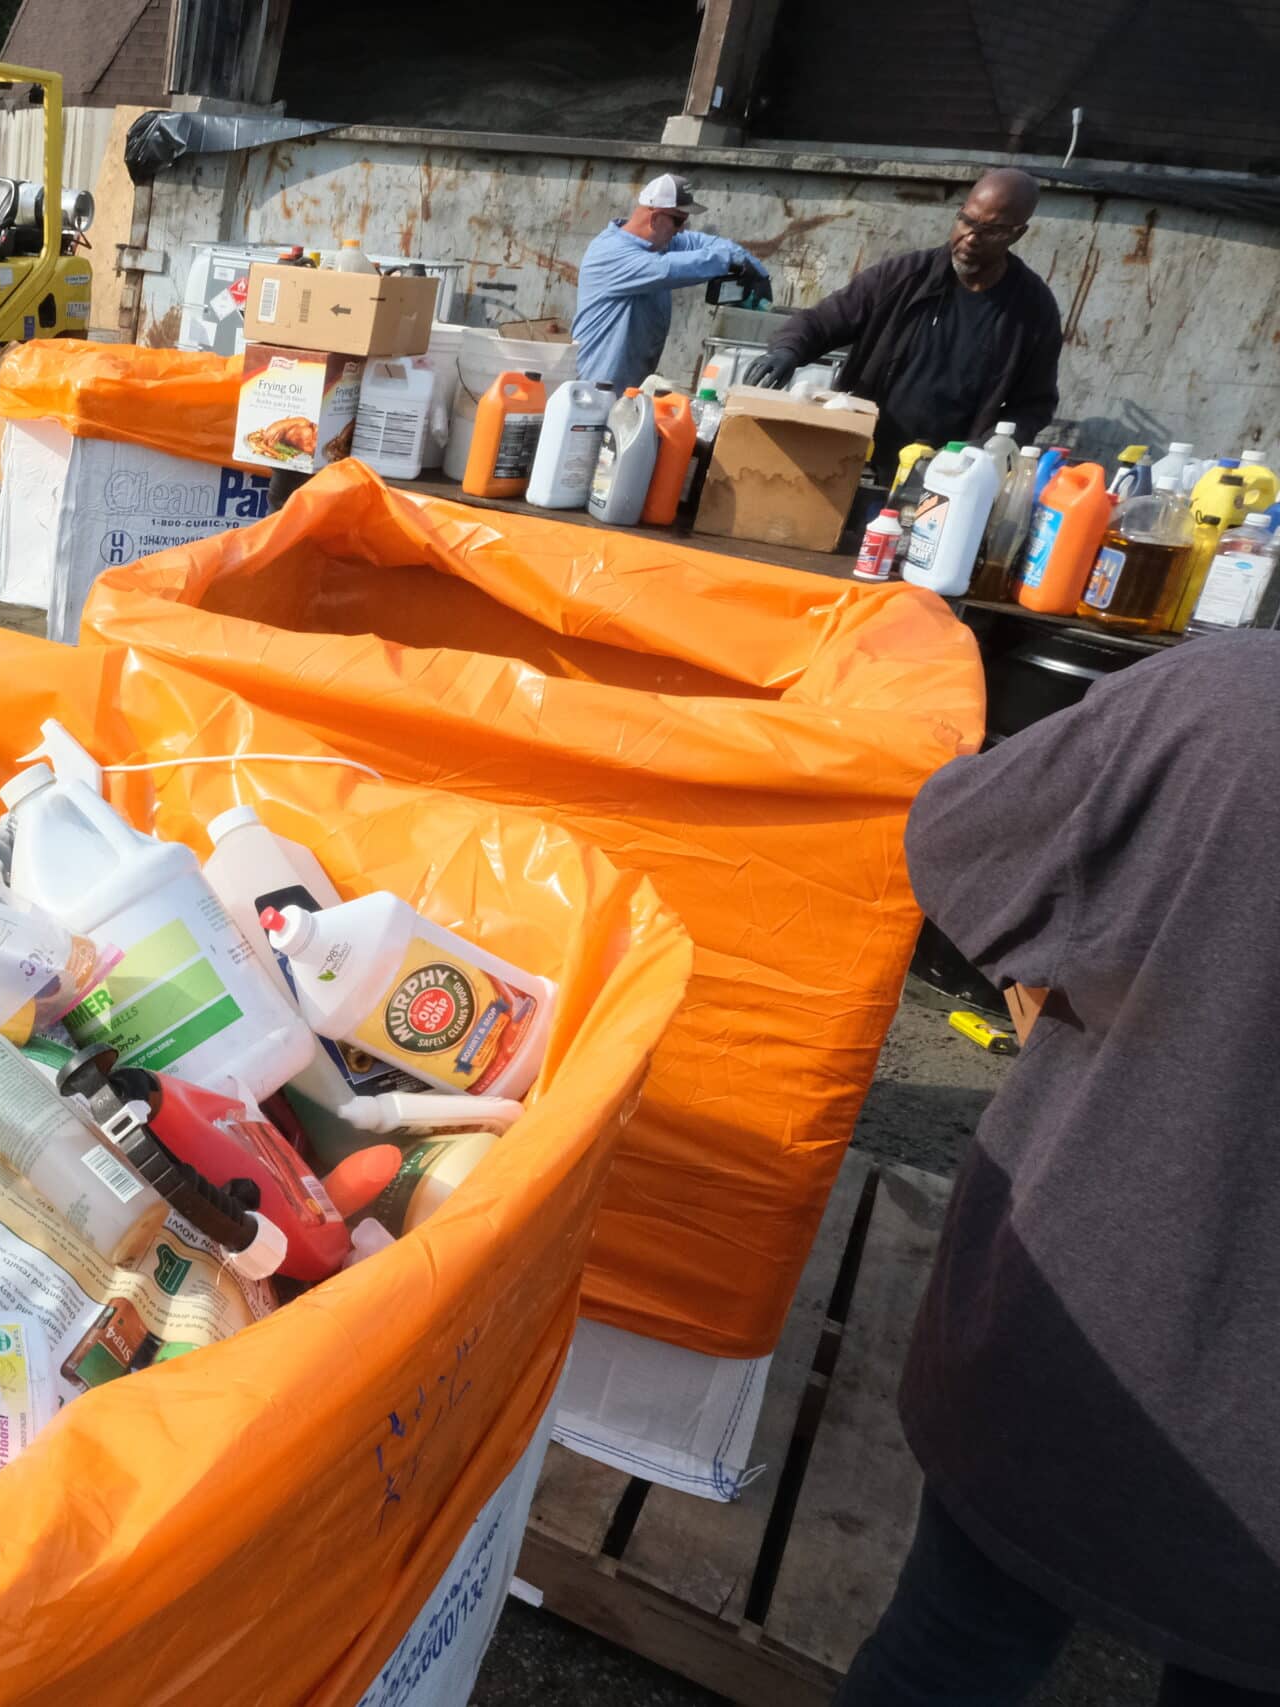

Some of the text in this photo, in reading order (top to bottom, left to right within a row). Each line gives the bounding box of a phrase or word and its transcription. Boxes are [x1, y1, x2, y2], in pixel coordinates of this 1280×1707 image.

[258, 379, 302, 394] Frying Oil
[390, 968, 450, 1042] MURPHY
[417, 981, 470, 1048] SAFELY CLEANS WOOD
[418, 1000, 437, 1021] OIL
[424, 998, 449, 1031] SOAP
[167, 1217, 199, 1242] NOW!
[1, 1256, 79, 1321] Guaranteed results
[0, 1414, 10, 1458] Floors!
